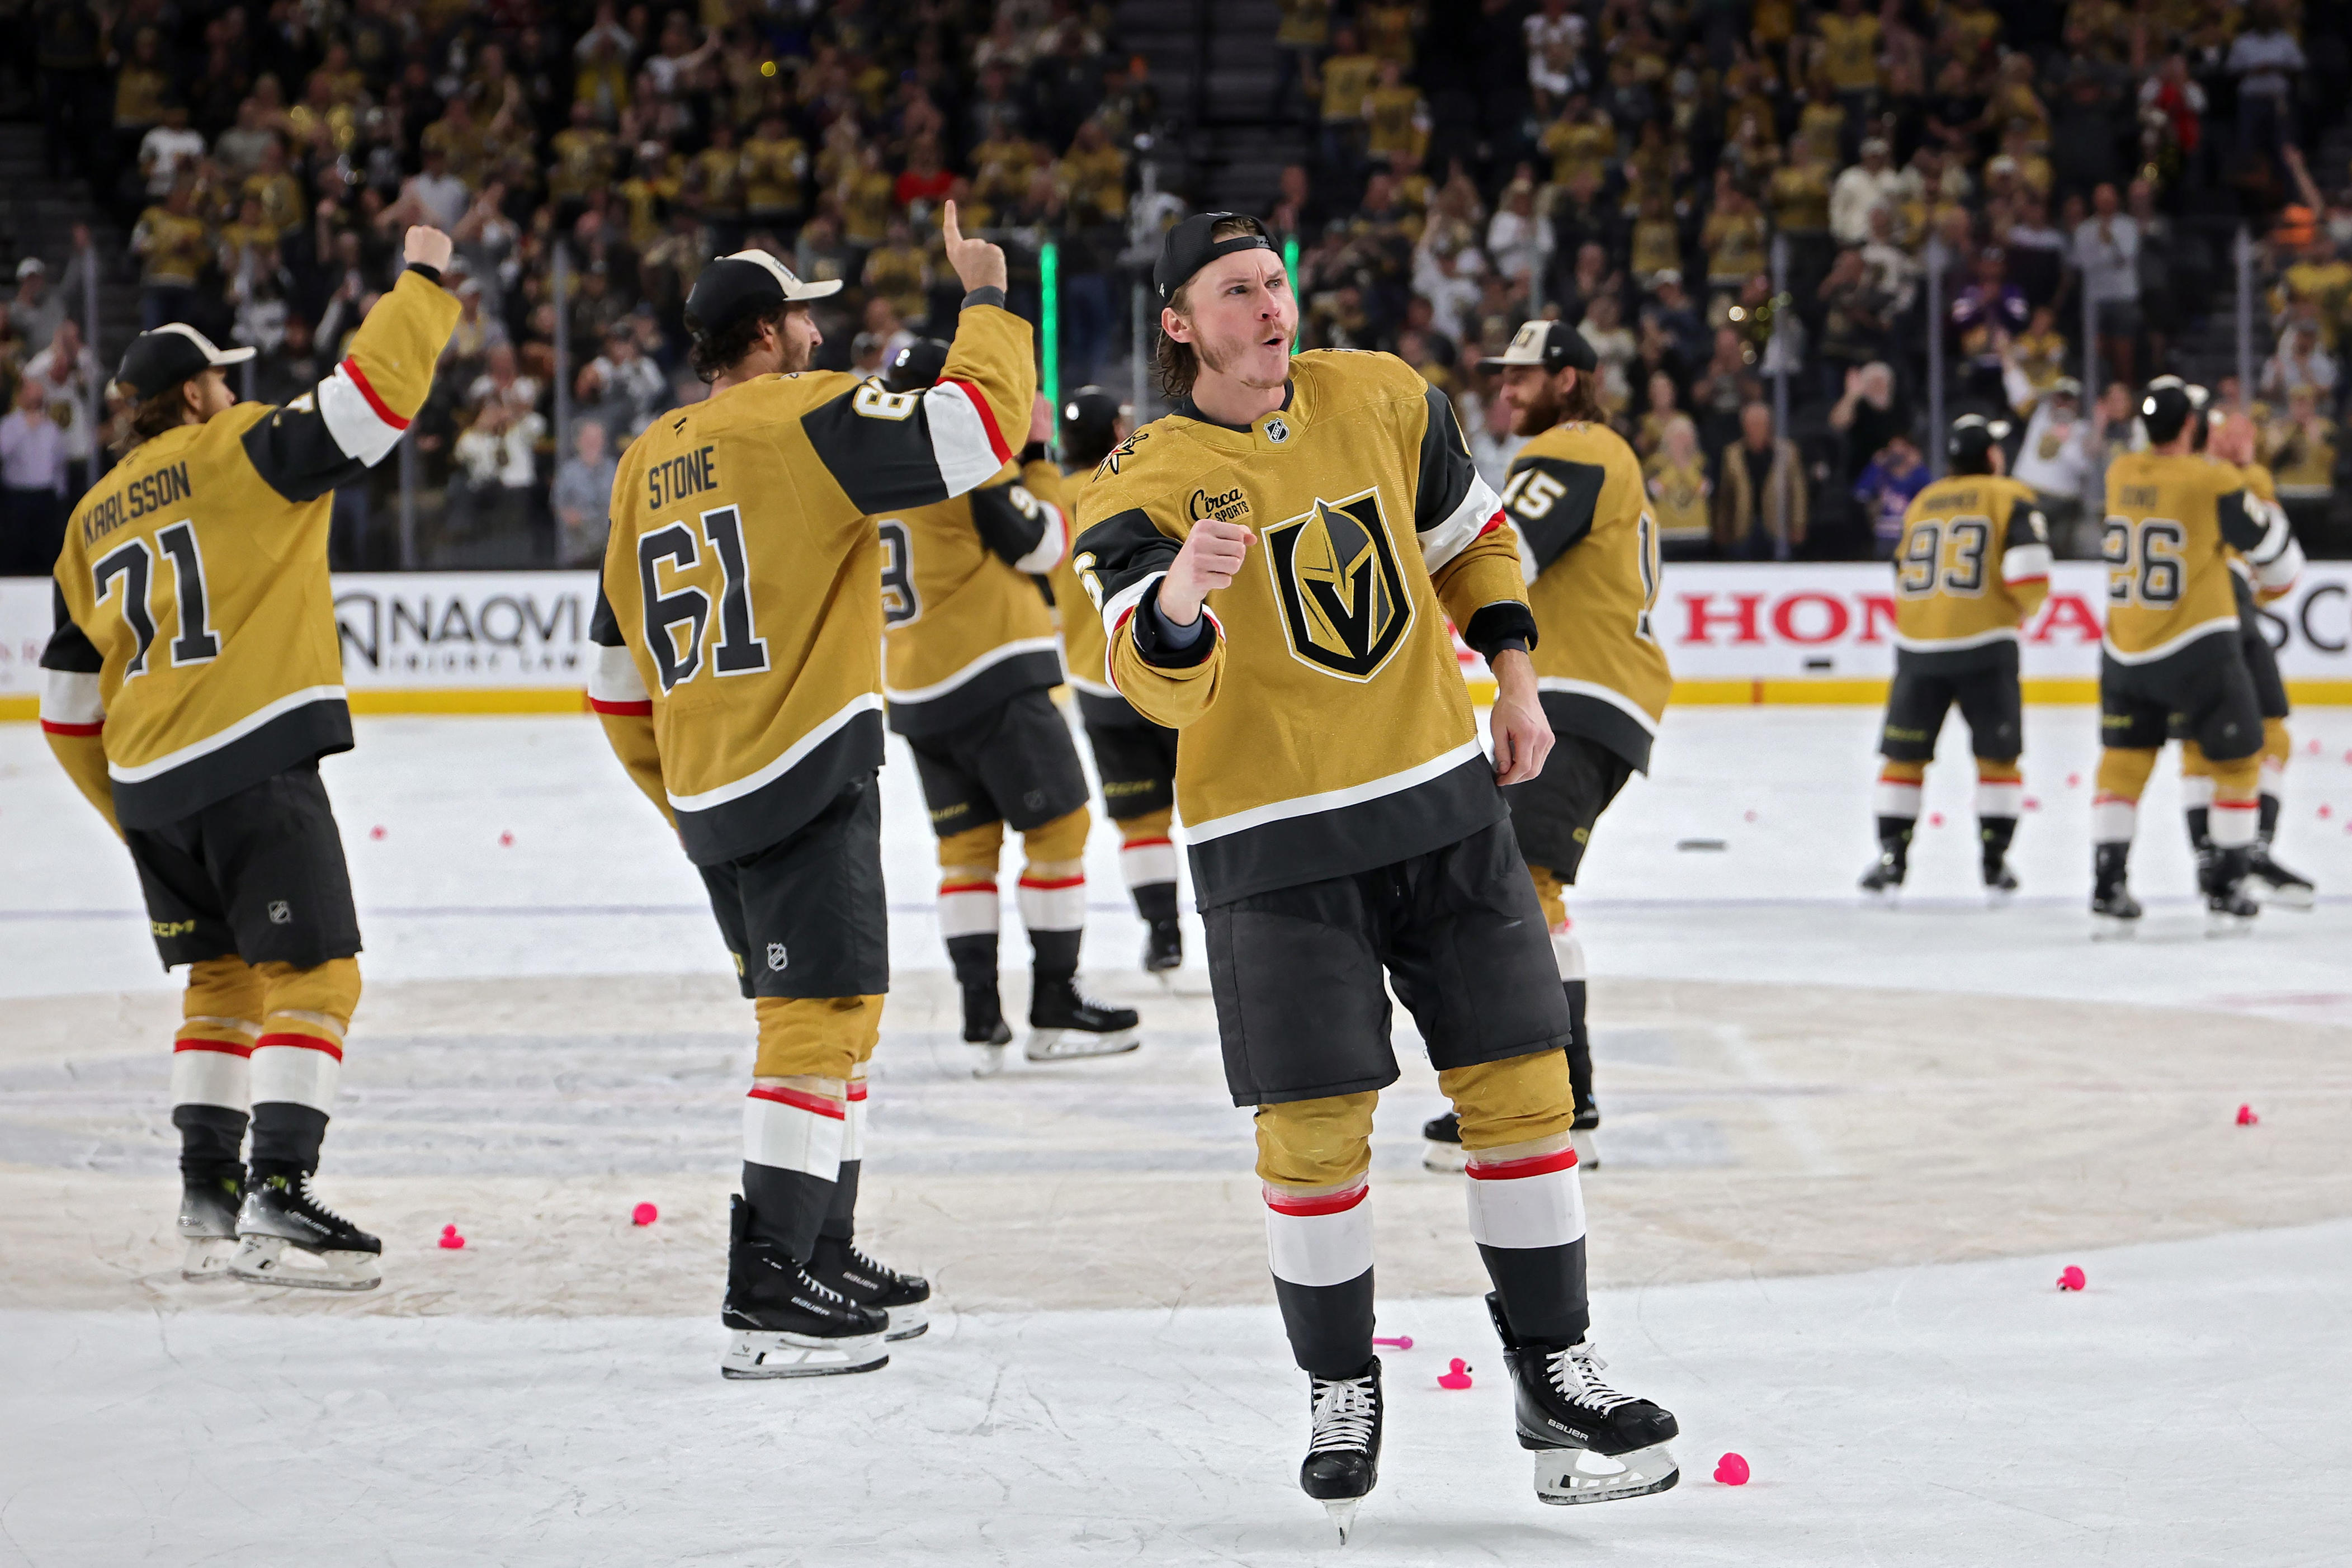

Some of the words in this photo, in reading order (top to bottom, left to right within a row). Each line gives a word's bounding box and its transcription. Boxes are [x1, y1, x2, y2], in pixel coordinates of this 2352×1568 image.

[82, 461, 192, 549] KARLSSON
[648, 446, 717, 509] STONE
[1189, 489, 1243, 522] Circa
[1500, 467, 1567, 520] 15
[1214, 500, 1250, 522] SPORTS
[1898, 514, 1995, 602] 93
[2103, 514, 2188, 611] 26
[92, 518, 222, 688] 71
[392, 595, 579, 645] NAQVI
[637, 503, 771, 698] 61
[1547, 1418, 1589, 1442] BAUER
